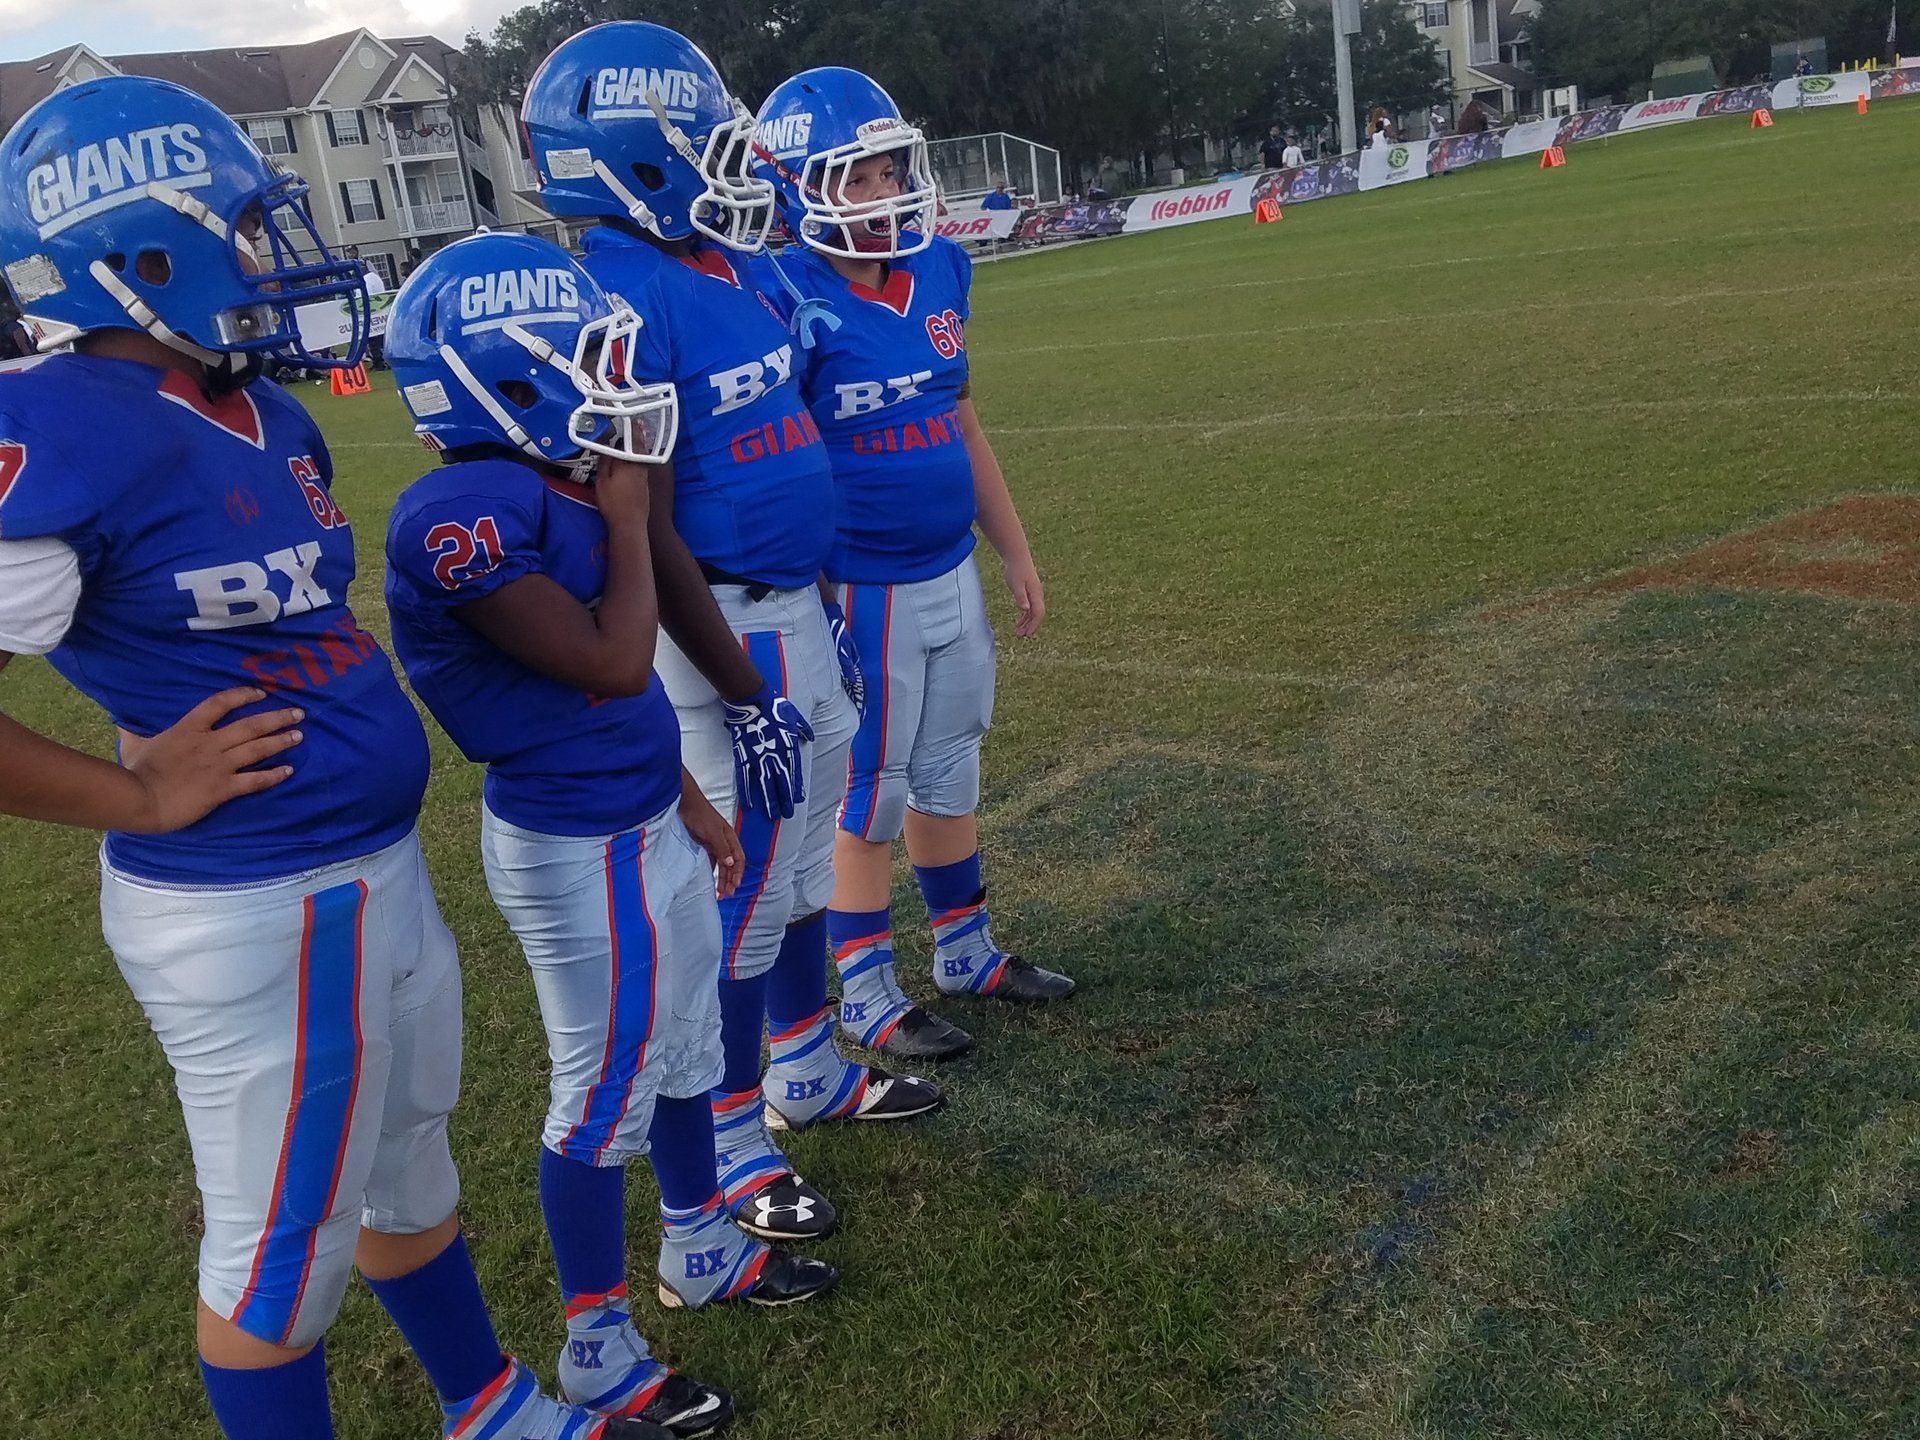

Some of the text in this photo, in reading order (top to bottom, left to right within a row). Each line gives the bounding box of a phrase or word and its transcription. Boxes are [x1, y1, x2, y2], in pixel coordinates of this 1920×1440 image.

[594, 67, 698, 108] GIANTS
[1552, 147, 1563, 163] 10
[25, 123, 207, 225] GIANTS
[1263, 199, 1279, 217] 20
[460, 268, 579, 320] GIANTS
[925, 309, 964, 359] 60
[343, 362, 366, 388] 40
[709, 343, 793, 417] BX
[834, 369, 932, 420] BX
[424, 516, 504, 590] 21
[173, 541, 332, 632] BX
[943, 956, 974, 978] BX
[842, 1002, 867, 1024] BX
[785, 1075, 827, 1101] BX
[684, 1247, 728, 1279] BX
[571, 1339, 605, 1369] BX
